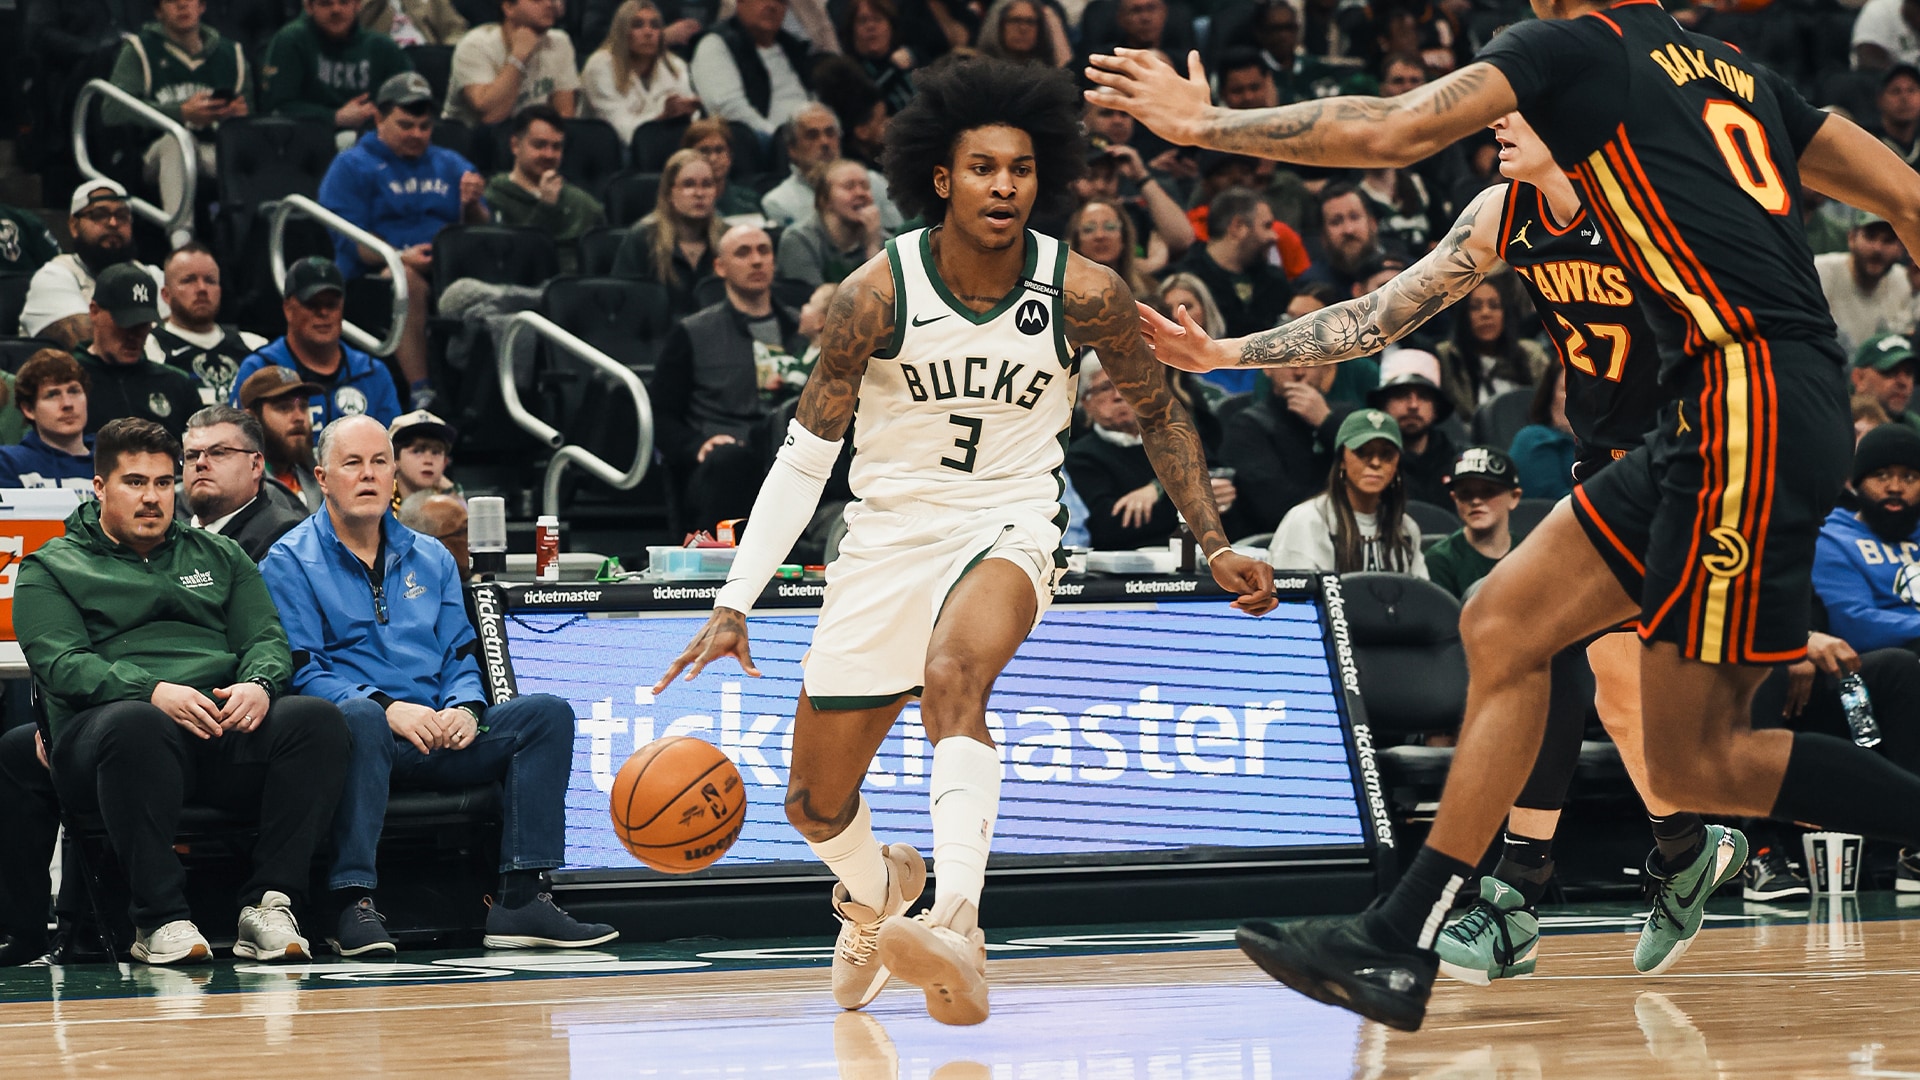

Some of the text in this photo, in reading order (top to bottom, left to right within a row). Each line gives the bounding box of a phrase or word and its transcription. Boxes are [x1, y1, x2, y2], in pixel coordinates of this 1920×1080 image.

[1702, 98, 1791, 216] 0
[1580, 229, 1592, 238] the
[1023, 280, 1059, 296] BRIDGEMAN
[1552, 310, 1632, 384] 27
[900, 357, 1054, 410] BUCKS
[940, 413, 983, 474] 3
[523, 589, 602, 605] ticketmaster
[652, 586, 721, 600] ticketmast
[778, 584, 824, 597] ticketm
[1125, 580, 1198, 594] ticketmaster
[1273, 577, 1308, 589] master
[477, 588, 513, 706] ticketmaste
[1322, 574, 1361, 696] ticketmaster
[1353, 723, 1395, 850] ticketmaster
